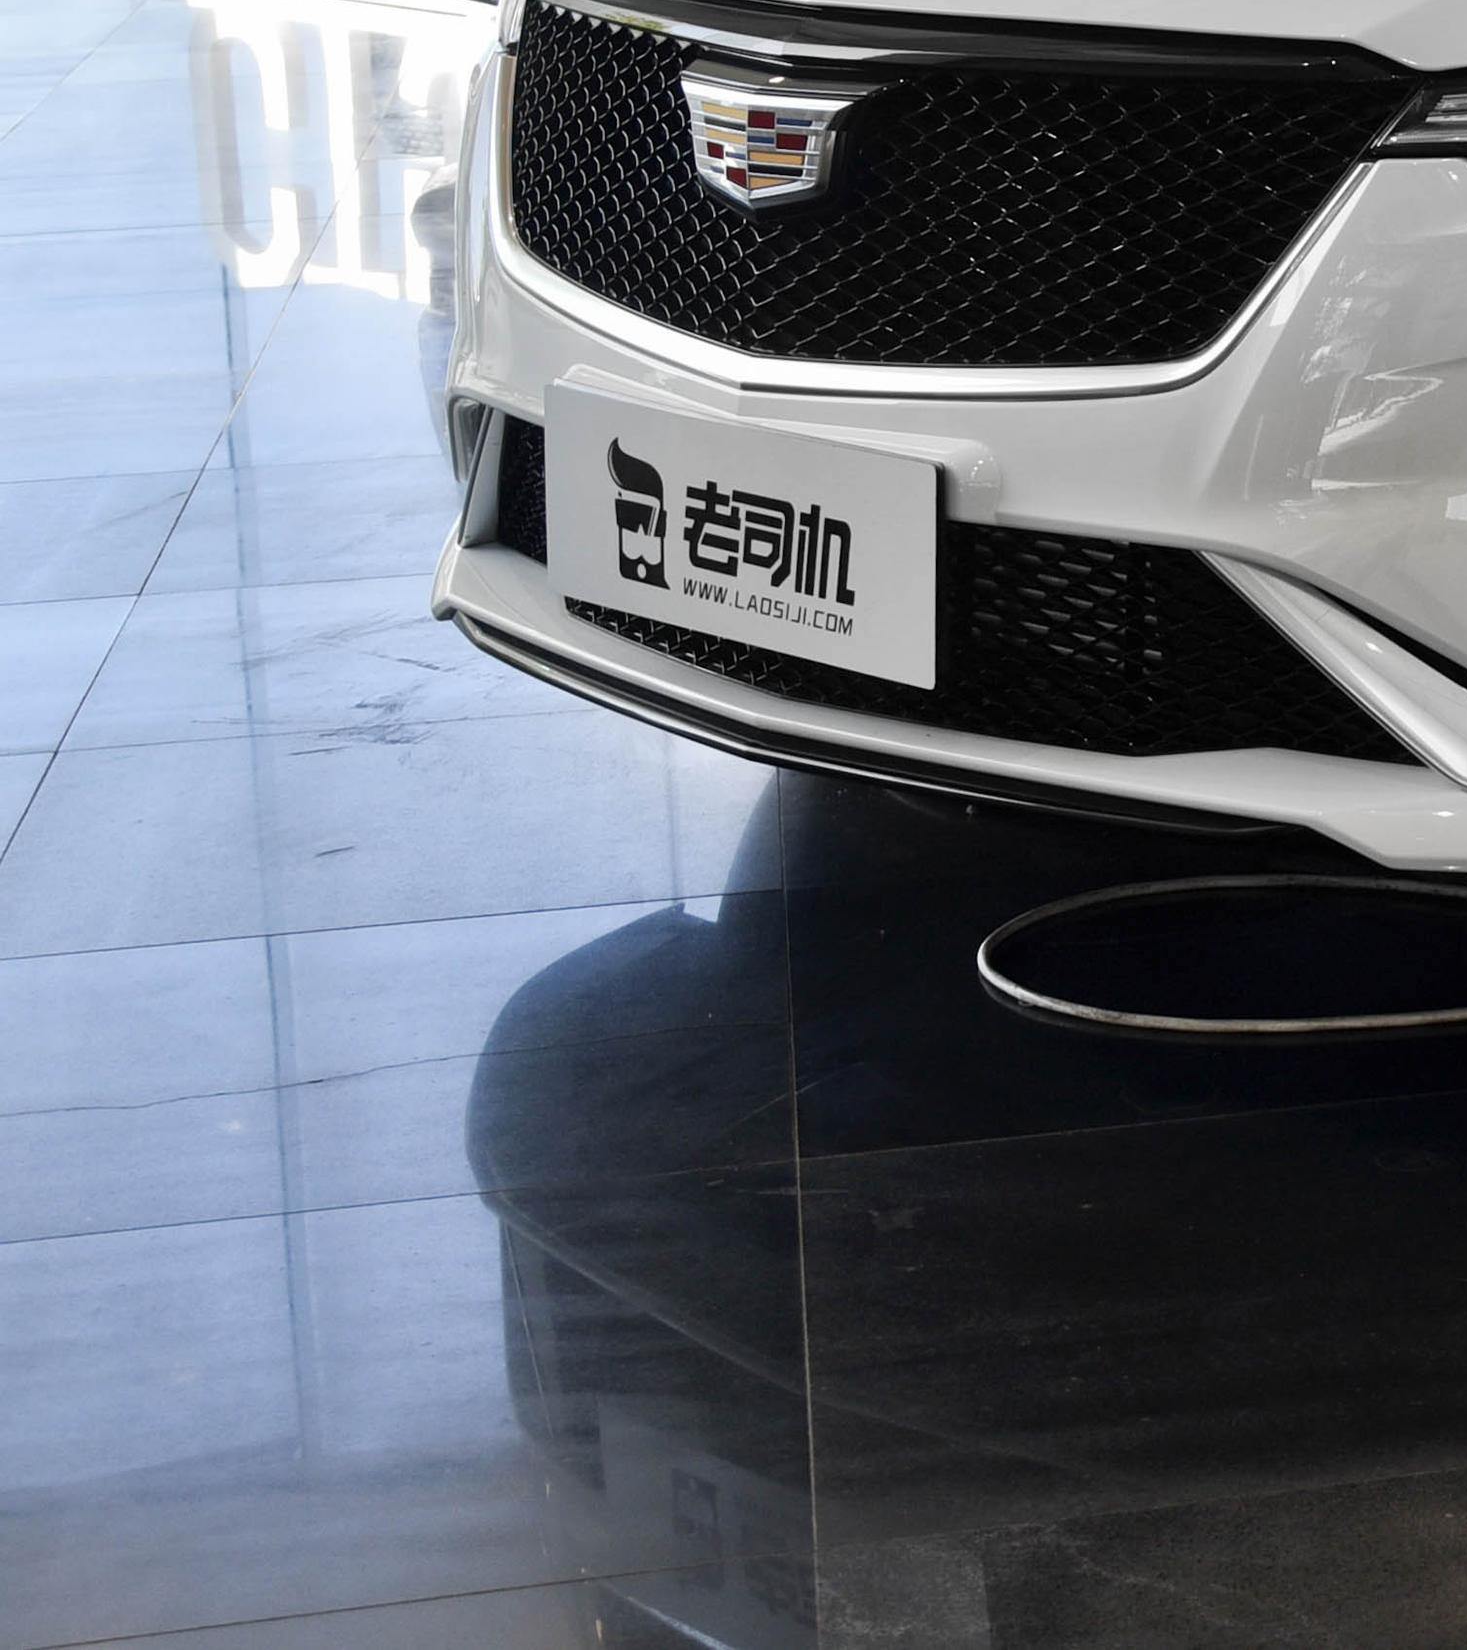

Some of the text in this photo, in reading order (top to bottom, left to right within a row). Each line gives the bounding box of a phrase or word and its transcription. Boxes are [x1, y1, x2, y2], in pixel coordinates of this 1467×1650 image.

[683, 480, 856, 607] 老司机
[683, 576, 854, 637] WWW.LAOSIJI.COM
